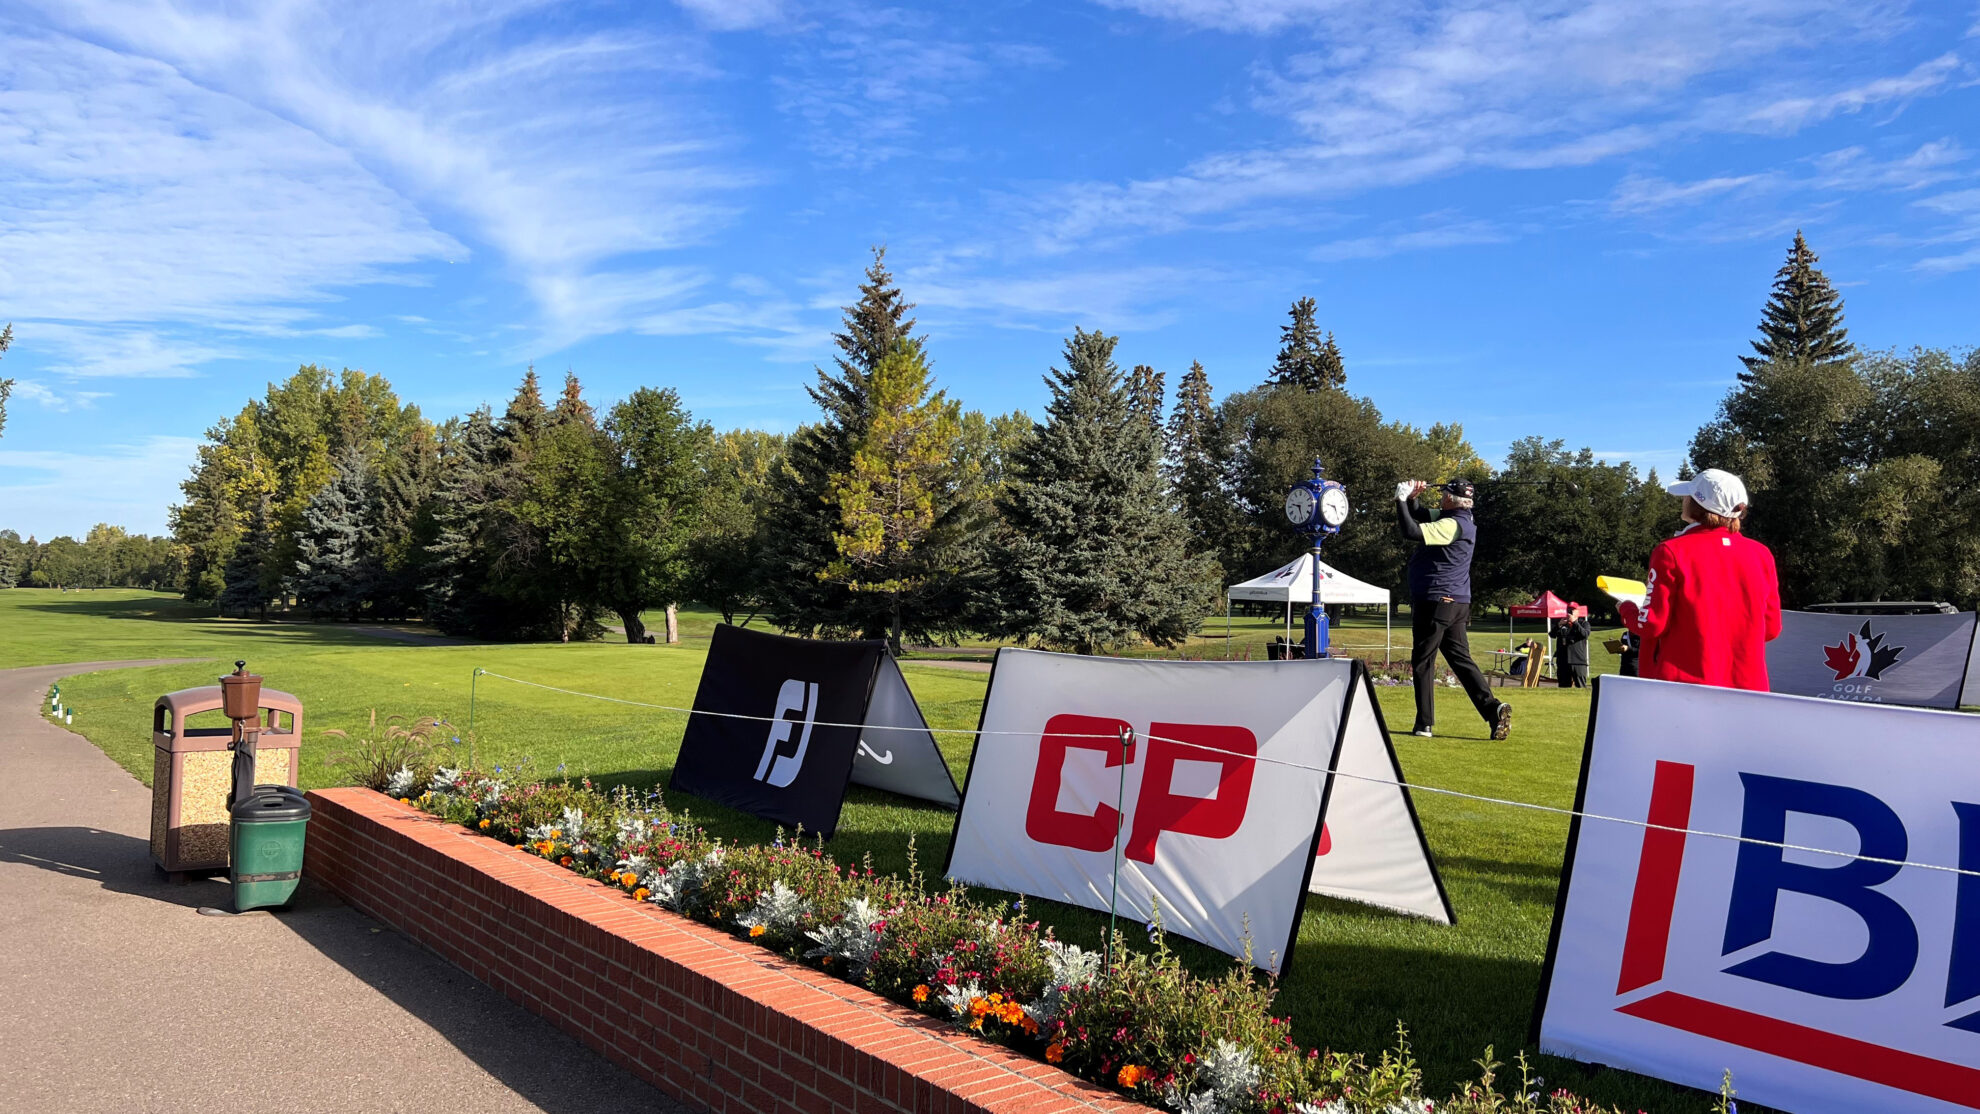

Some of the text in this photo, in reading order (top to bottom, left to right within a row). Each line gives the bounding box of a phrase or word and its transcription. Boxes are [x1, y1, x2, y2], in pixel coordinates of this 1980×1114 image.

[1833, 683, 1872, 694] GOLF
[1025, 713, 1258, 865] CP
[1719, 771, 1980, 1034] B
